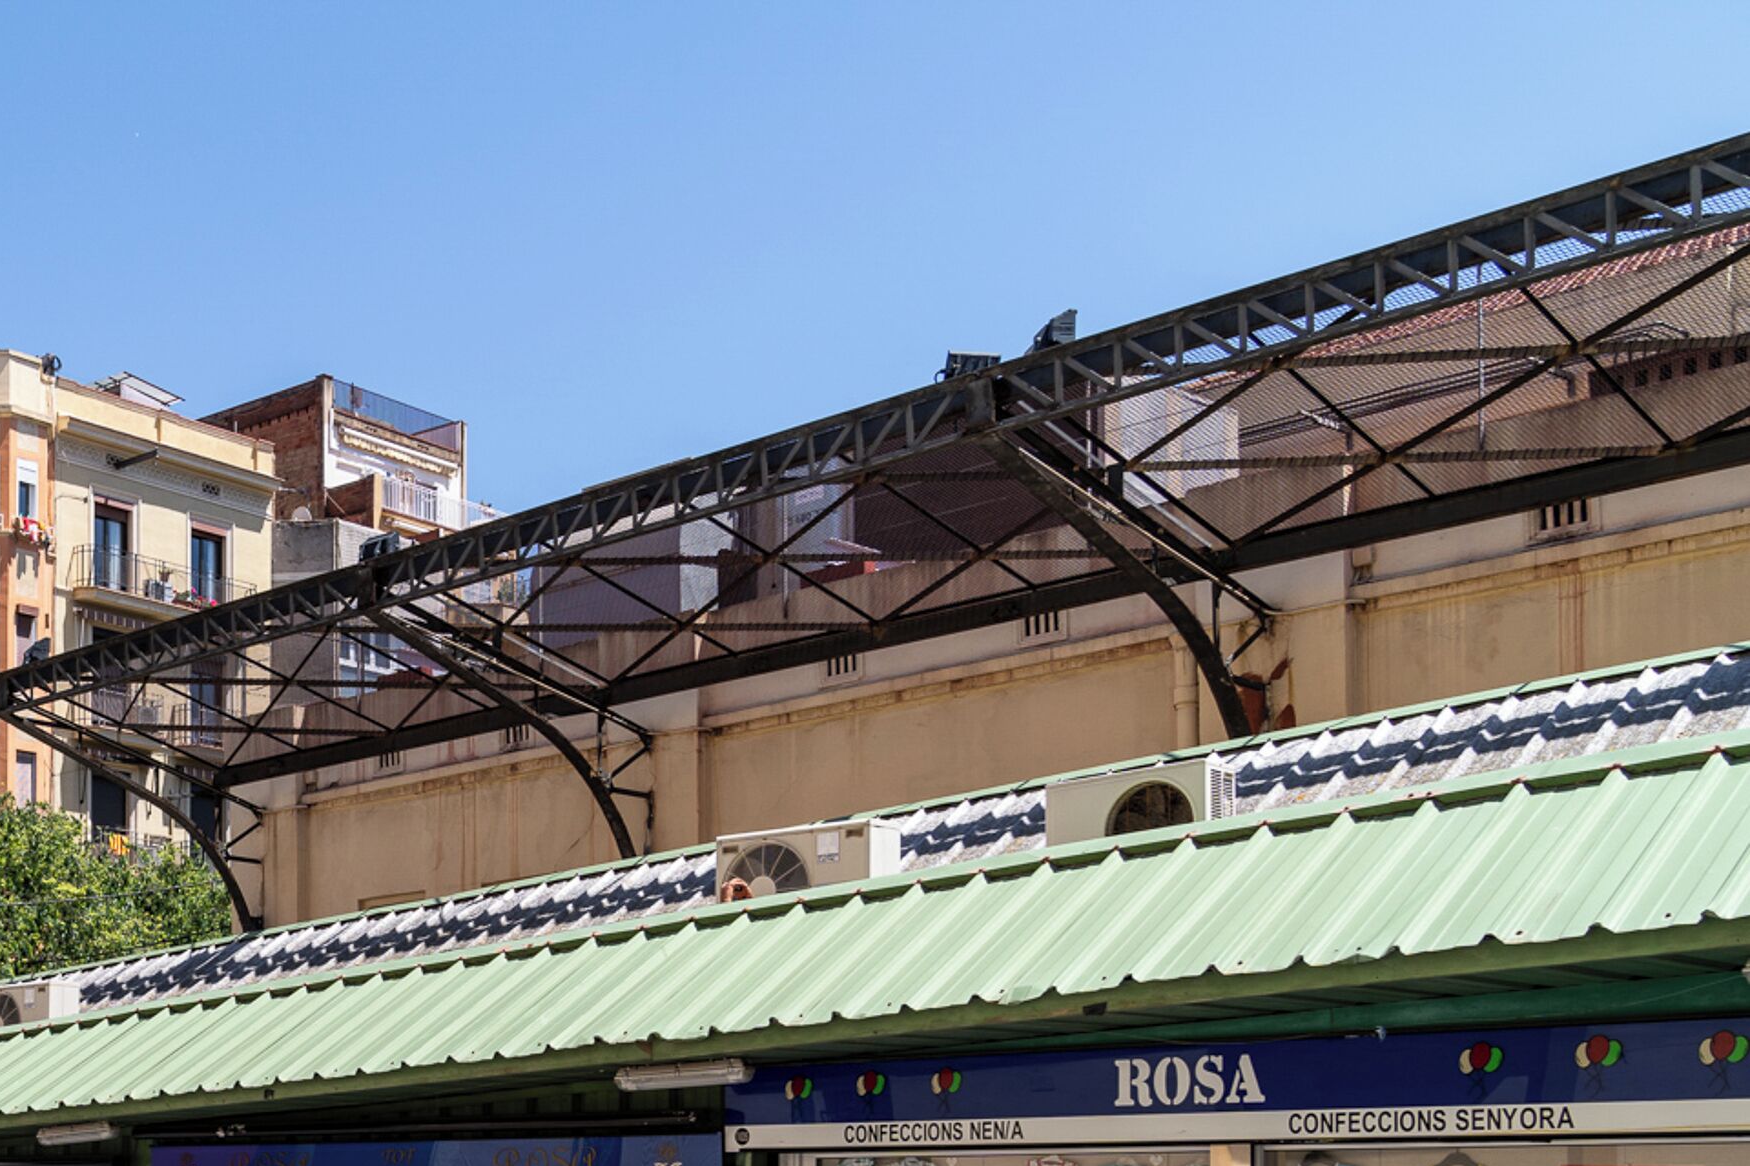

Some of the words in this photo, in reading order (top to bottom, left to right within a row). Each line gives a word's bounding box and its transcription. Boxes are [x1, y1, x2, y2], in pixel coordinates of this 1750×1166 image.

[1114, 1053, 1265, 1107] ROSA
[843, 1122, 964, 1143] CONFECCIONS
[969, 1120, 1025, 1140] NEN/A
[1288, 1111, 1447, 1134] CONFECCIONS
[1455, 1107, 1575, 1131] SENYORA
